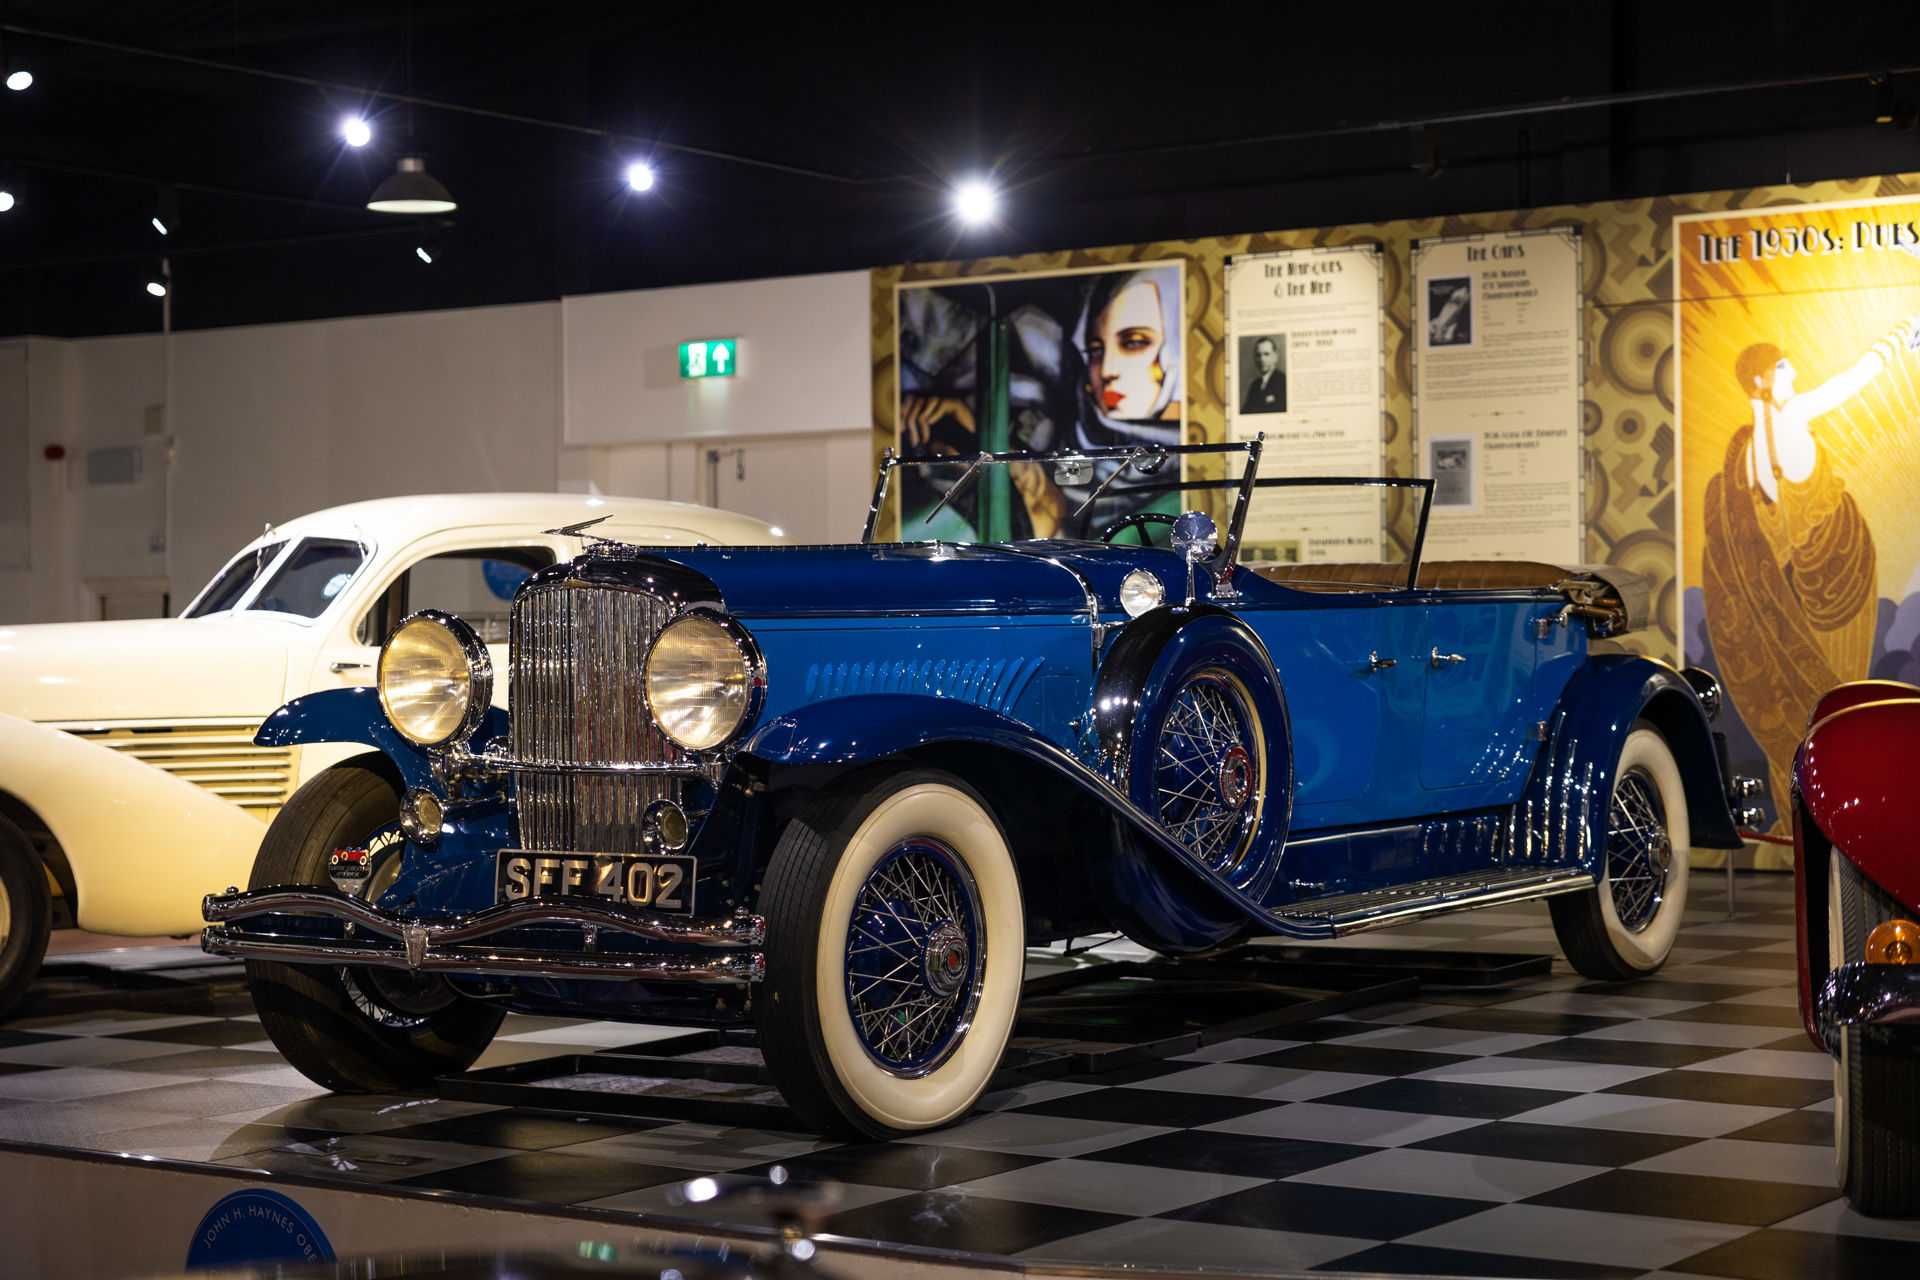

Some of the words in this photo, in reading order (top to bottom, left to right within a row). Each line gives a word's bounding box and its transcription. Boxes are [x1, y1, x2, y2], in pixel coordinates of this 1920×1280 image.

[1697, 233, 1742, 264] THE
[1851, 221, 1920, 253] DUES
[505, 857, 589, 900] SFF
[597, 861, 684, 909] 402
[204, 1213, 231, 1248] JOHN
[232, 1208, 245, 1220] H.
[248, 1205, 294, 1234] HAYNES
[296, 1233, 317, 1263] OBE
